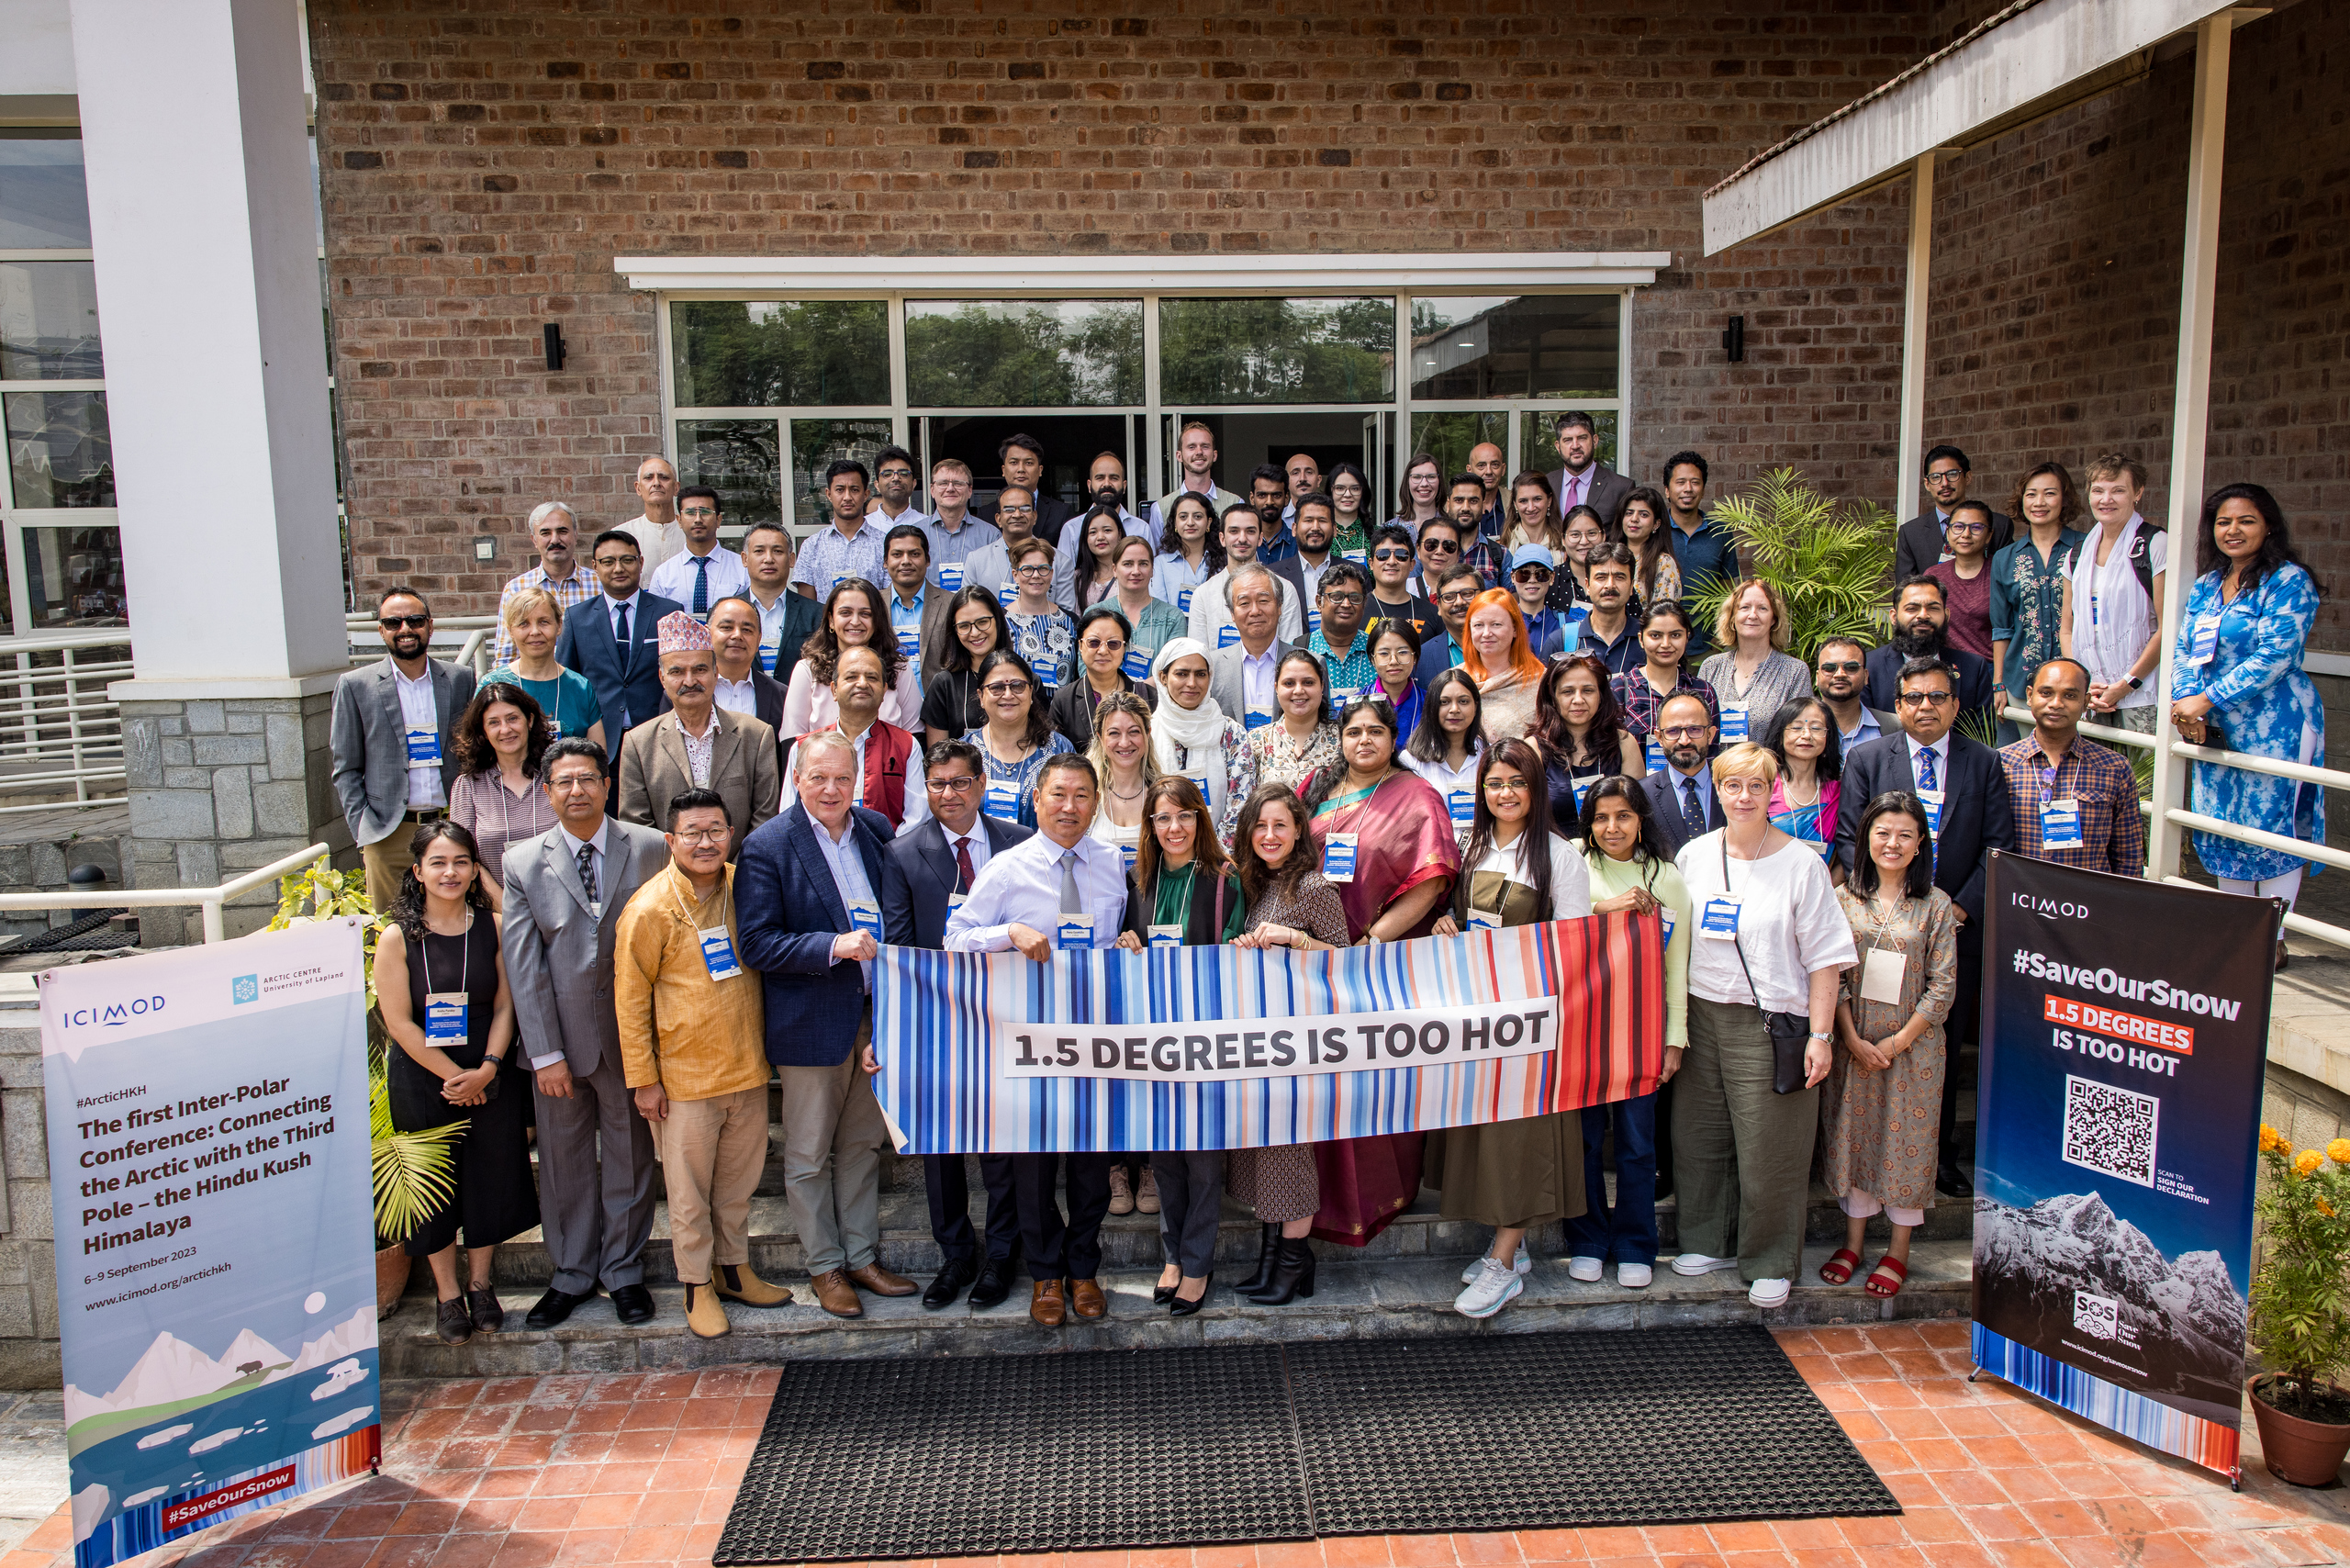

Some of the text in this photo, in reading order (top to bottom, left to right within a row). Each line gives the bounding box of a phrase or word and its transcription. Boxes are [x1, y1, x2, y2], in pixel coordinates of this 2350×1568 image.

[2011, 891, 2089, 920] ICIMOD
[263, 967, 321, 984] ARCTIC CENTRE
[263, 970, 344, 992] University of Lapland
[2013, 948, 2242, 1022] #SaveOurSnow
[64, 995, 165, 1028] ICIMOD
[2046, 998, 2190, 1050] 1.5 DEGREES
[1015, 1010, 1550, 1072] 1.5 DEGREES IS TOO HOT
[2053, 1028, 2180, 1077] IS TOO HOT
[76, 1084, 147, 1109] #ArcticHKH
[77, 1077, 290, 1140] The first Inter-Polar
[79, 1094, 332, 1169] Conference: Connecting
[80, 1115, 335, 1198] the Arctic with the Third
[2157, 1169, 2185, 1182] SCAN TO
[83, 1200, 134, 1227] Pole
[153, 1182, 192, 1209] the
[196, 1167, 259, 1198] Hindu
[263, 1151, 312, 1181] Kush
[2156, 1176, 2195, 1193] SIGN OUR
[2156, 1183, 2210, 1205] DECLARATION
[84, 1213, 192, 1256] Himalaya
[106, 1253, 170, 1284] September
[171, 1246, 197, 1263] 2023
[84, 1262, 231, 1312] www.icimod.org/arctichkh
[2076, 1295, 2115, 1322] SOS
[2118, 1320, 2139, 1334] Save
[2117, 1327, 2137, 1340] Our
[2117, 1335, 2143, 1350] Snow
[2061, 1338, 2148, 1377] www.icimod.org/saveoursnow
[168, 1472, 290, 1524] #SaveOurSnow
